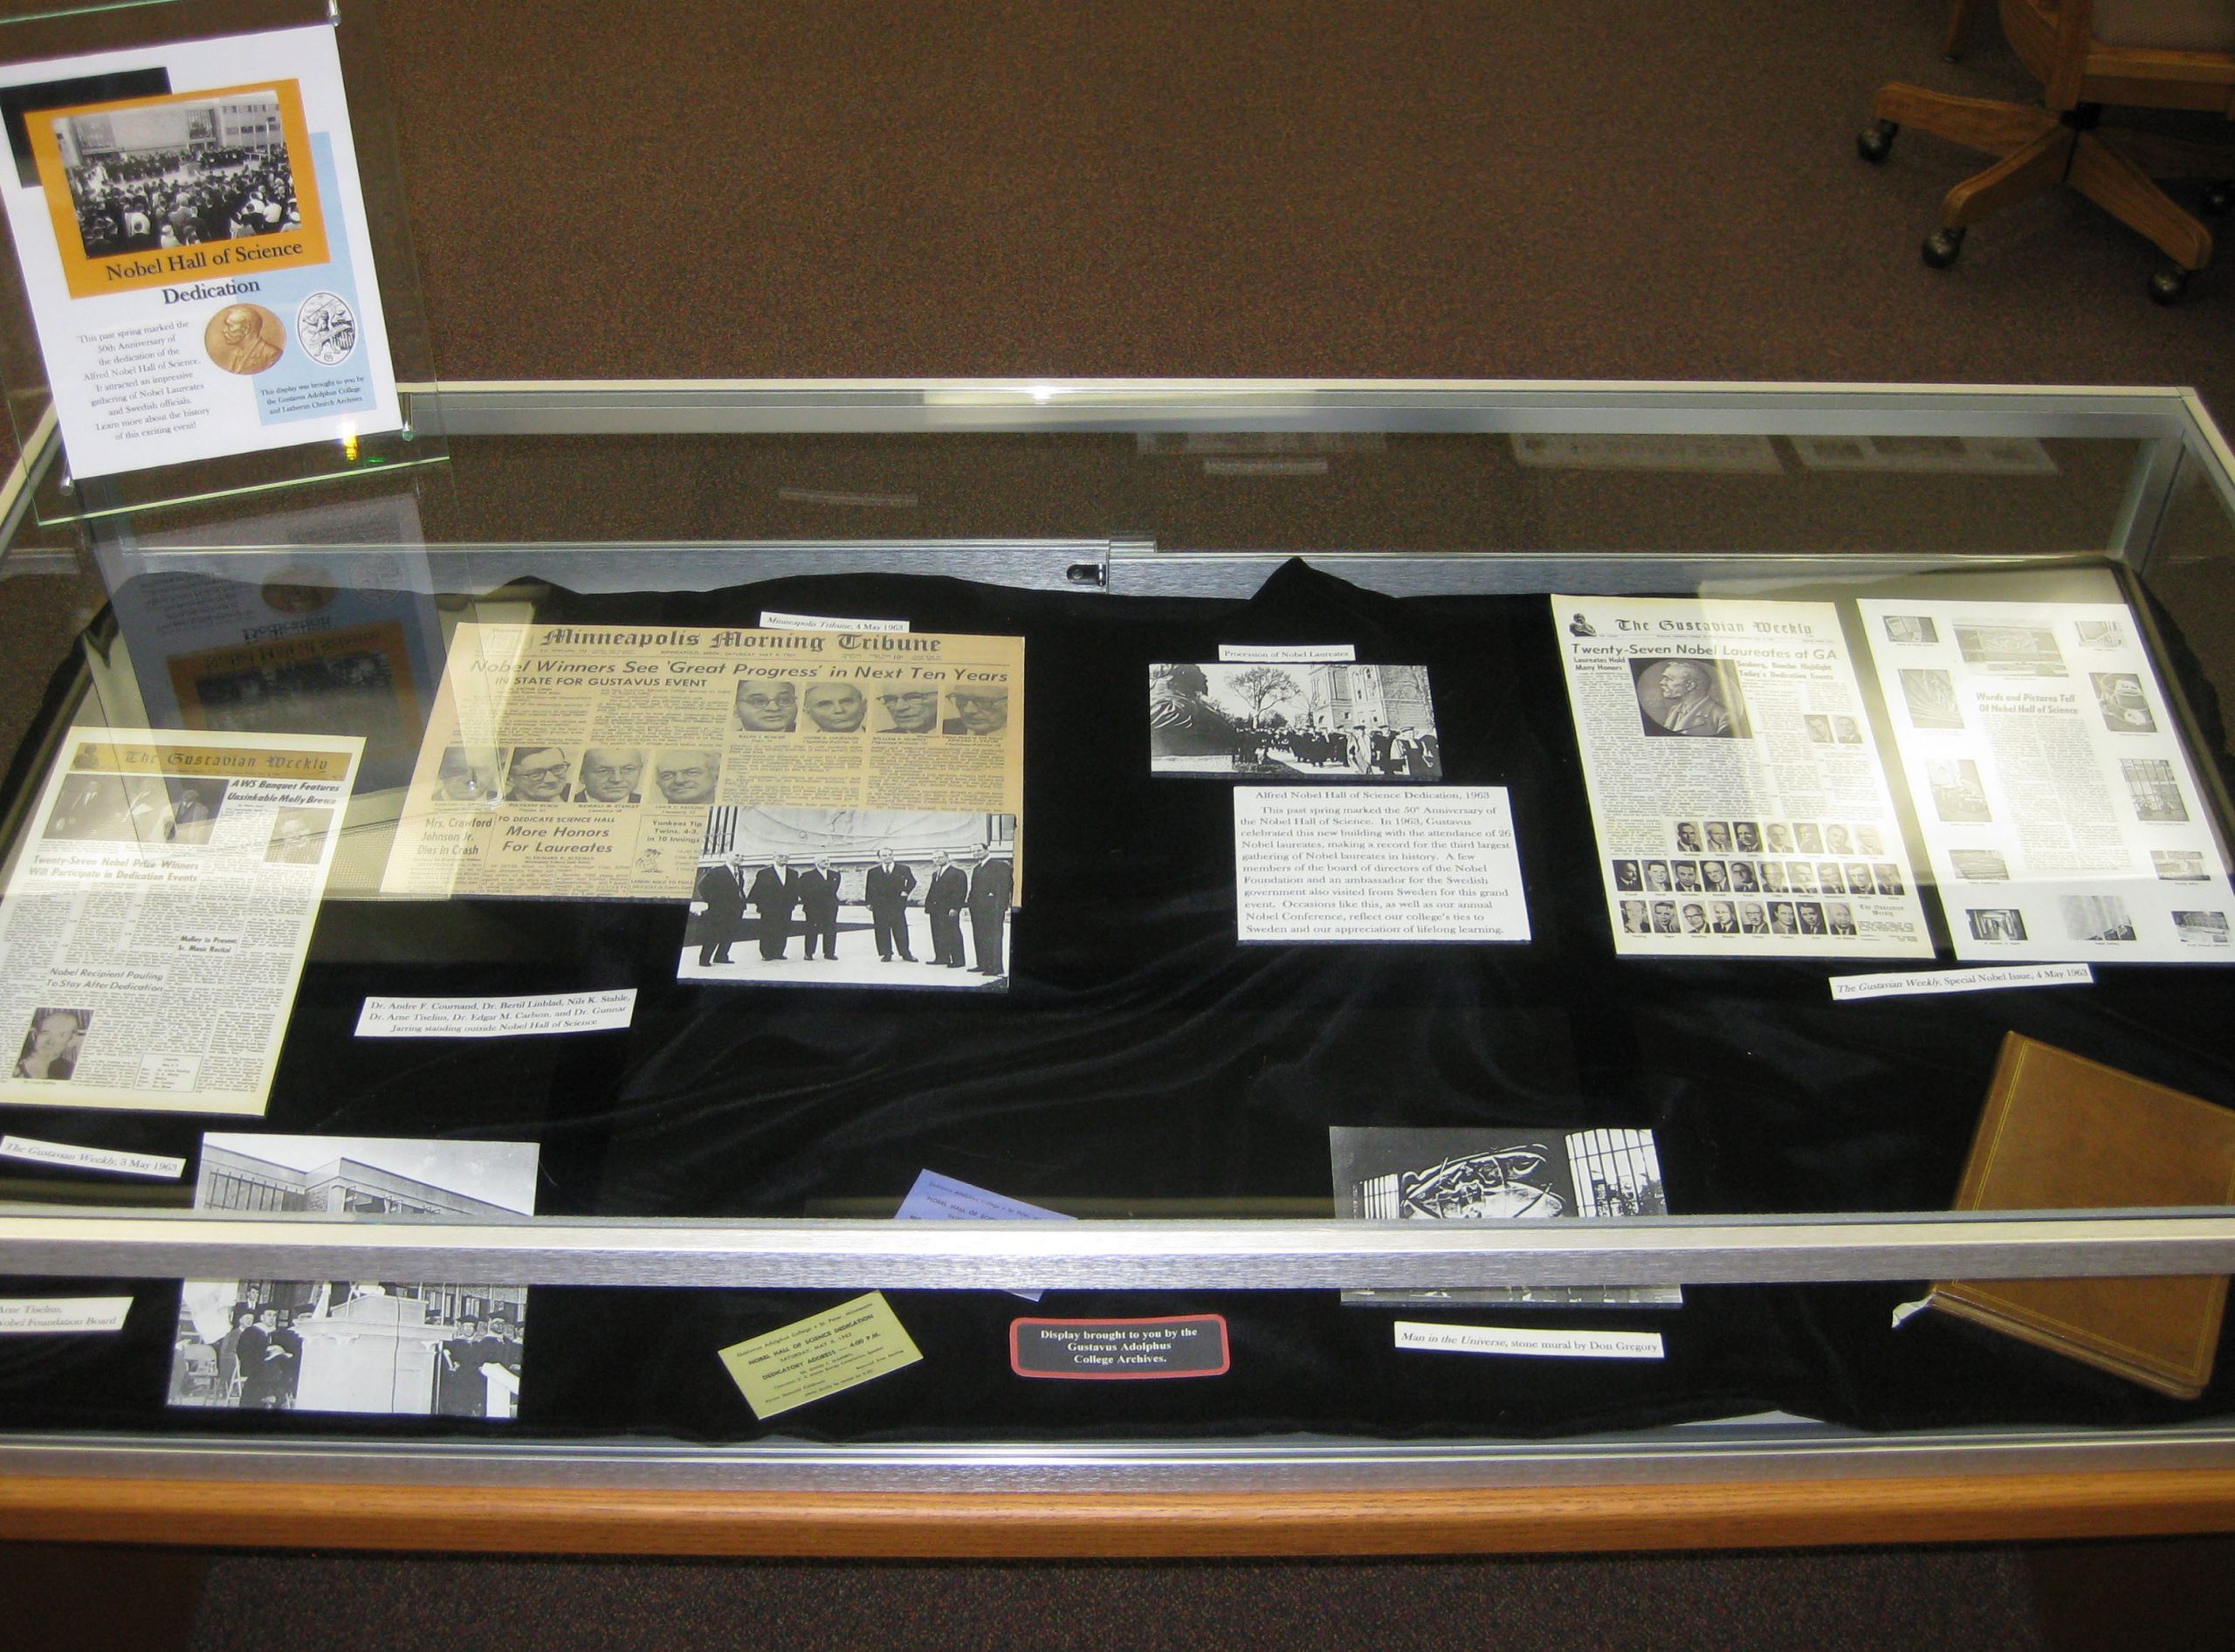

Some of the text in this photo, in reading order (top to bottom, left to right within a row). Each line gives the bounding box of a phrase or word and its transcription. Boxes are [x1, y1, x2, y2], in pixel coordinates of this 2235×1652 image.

[107, 243, 303, 281] Nobel Hall of Science
[162, 279, 260, 304] Dedication
[78, 334, 97, 343] This
[99, 333, 116, 342] past
[117, 327, 142, 340] spring
[144, 324, 175, 334] marked
[767, 616, 816, 628] Minneapolis
[863, 623, 882, 633] May
[1616, 619, 1812, 635] The Gustavian Weekly
[540, 628, 941, 652] Minneapolis Morning Tribune
[1571, 644, 1837, 660] Twenty-Seven Nobel Laureates at GA
[470, 659, 529, 672] Nobel
[537, 660, 615, 673] Winners
[622, 661, 658, 673] See
[830, 665, 848, 678] in
[855, 665, 903, 678] Next
[911, 667, 945, 680] Ten
[953, 669, 1007, 682] Years
[495, 677, 706, 687] IN STATE FOR GUSTAVUS EVENT
[1976, 692, 2075, 703] Words and Pictures Tell
[1979, 704, 1990, 712] Of
[1991, 705, 2017, 713] Nobel
[2038, 706, 2046, 714] of
[2048, 706, 2079, 715] Science
[126, 750, 327, 774] The Gustavian Weekly
[231, 780, 340, 793] AWS Banquet Features
[227, 792, 278, 804] Unsinkable
[277, 794, 306, 805] Molly
[1405, 791, 1462, 800] Dedication,
[425, 817, 492, 828] Mrs. Crawford
[421, 831, 474, 842] Johnson Jr.
[505, 826, 610, 837] More Honors
[417, 845, 478, 855] Dies in Crash
[502, 841, 612, 854] For Laureates
[1246, 925, 1287, 933] Sweden
[1334, 926, 1400, 935] appreciation
[1403, 925, 1414, 933] of
[1417, 925, 1455, 935] lifelong
[1459, 925, 1503, 934] learning.
[49, 967, 163, 981] Nobel Recipient Pauling
[1859, 981, 1902, 991] Gustavian
[1906, 979, 1942, 988] Weekly,
[1944, 976, 1976, 986] Special
[1978, 974, 2006, 983] Nobel
[2009, 972, 2034, 981] Issue,
[2043, 969, 2064, 979] May
[46, 979, 163, 991] To Stay After Dedication
[6, 1143, 24, 1152] The
[28, 1147, 75, 1160] Gustavian
[127, 1160, 149, 1170] May
[153, 1162, 177, 1171] 1963
[1041, 1331, 1080, 1340] Display
[1083, 1330, 1126, 1340] brought
[1129, 1329, 1139, 1338] to
[1142, 1331, 1161, 1340] you
[1166, 1328, 1177, 1339] by
[1068, 1341, 1171, 1352] Gustavus Adolphus
[1401, 1332, 1424, 1341] Man
[1441, 1334, 1457, 1344] the
[1461, 1336, 1507, 1347] Universe,
[1541, 1340, 1571, 1349] mural
[1574, 1341, 1585, 1350] by
[1589, 1341, 1613, 1350] Don
[1616, 1342, 1657, 1352] Gregory
[1074, 1354, 1166, 1364] College Archives.
